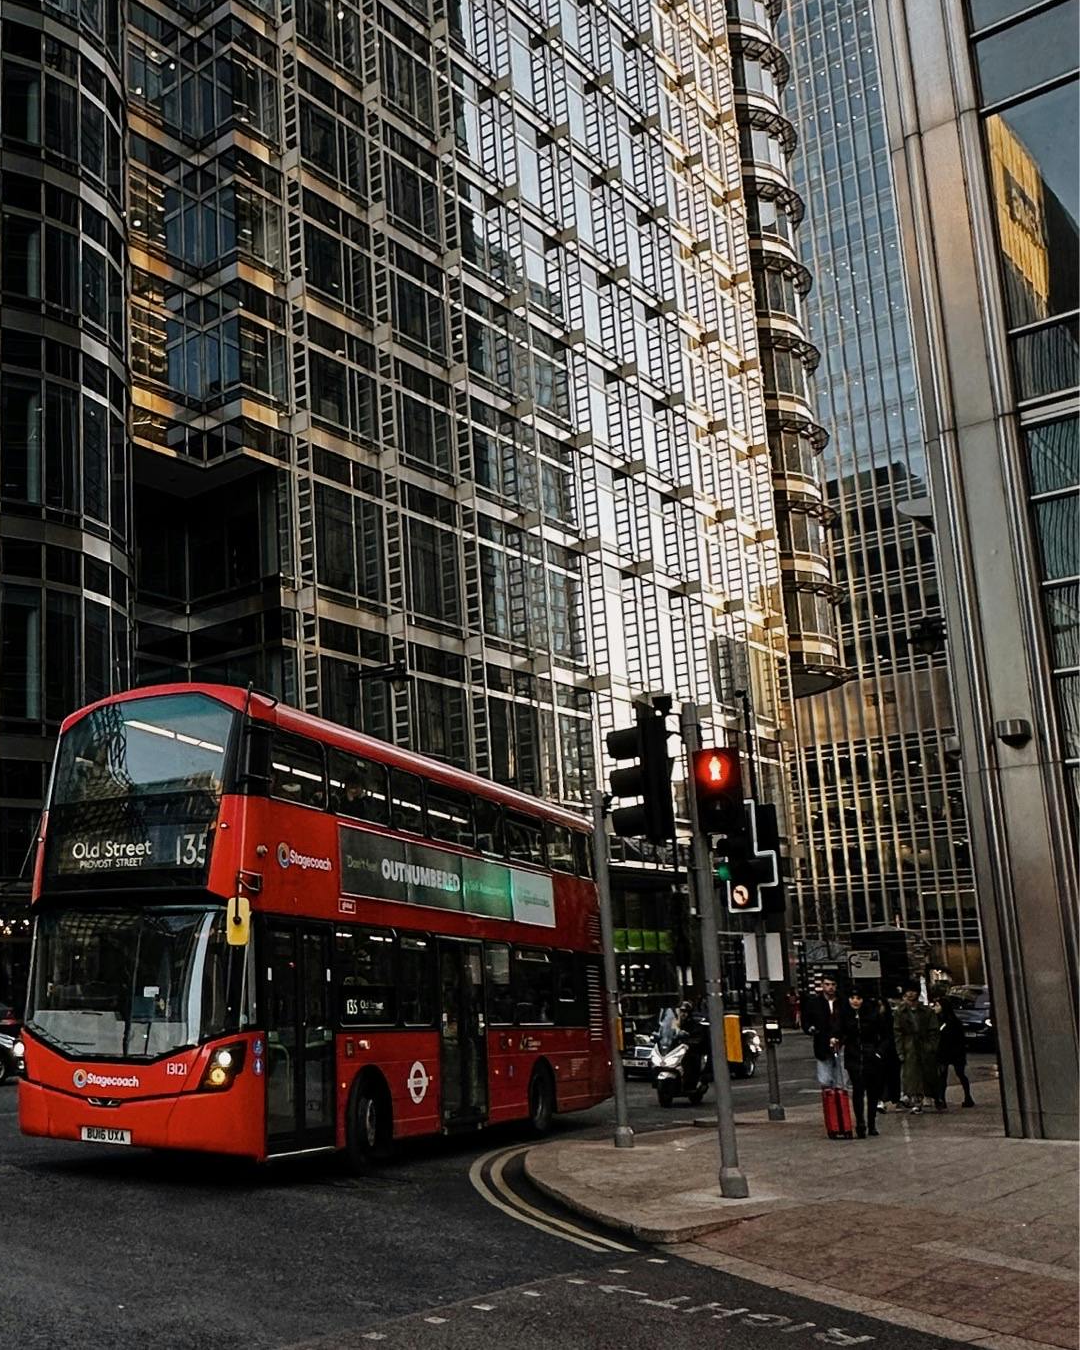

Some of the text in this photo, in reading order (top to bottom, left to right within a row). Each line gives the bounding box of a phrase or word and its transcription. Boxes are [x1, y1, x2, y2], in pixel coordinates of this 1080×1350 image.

[72, 840, 152, 859] Old Street
[176, 832, 207, 865] 135
[80, 857, 144, 869] PROVOST STREET
[289, 849, 332, 871] Stagecoach
[381, 858, 461, 892] OUTNUMBERED
[166, 1063, 187, 1075] 13121
[86, 1072, 139, 1088] Stagecoach
[86, 1127, 126, 1142] BU16 UXA
[638, 1295, 876, 1346] RIGHT
